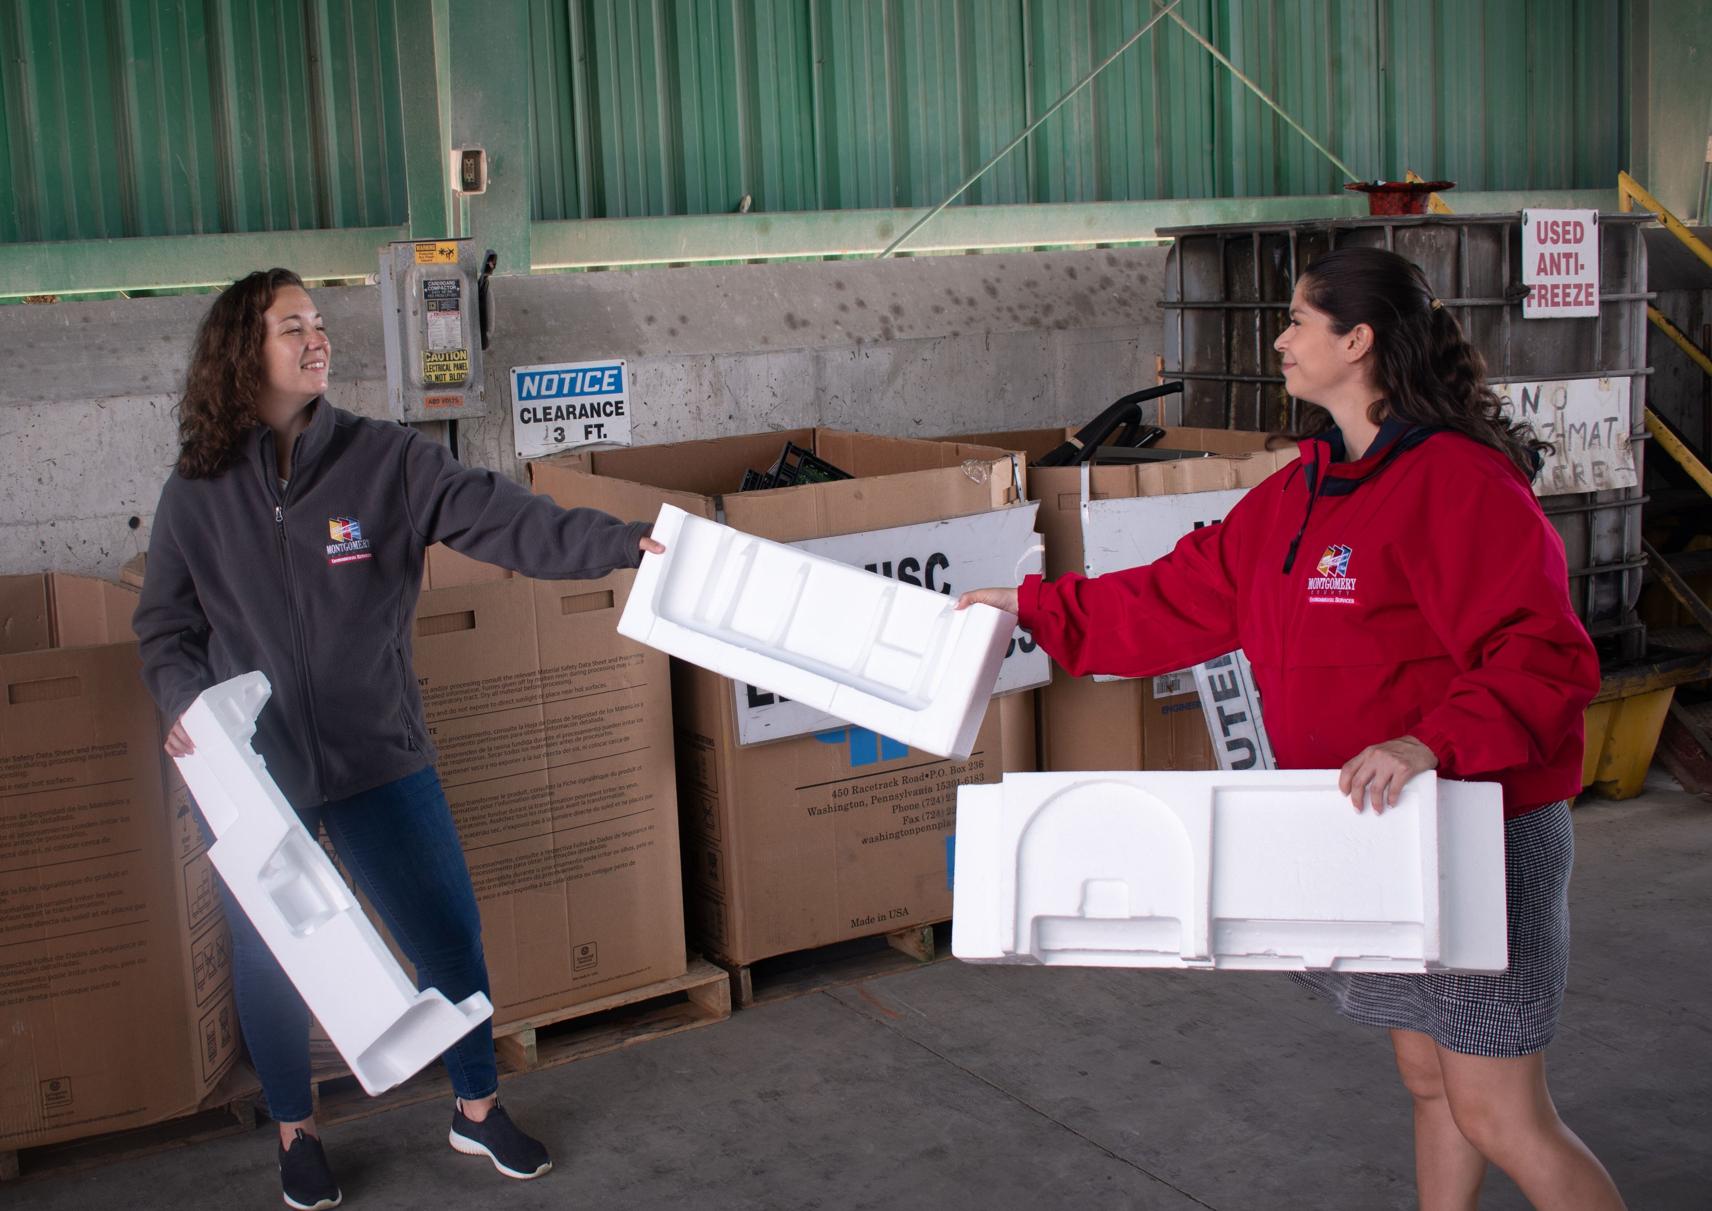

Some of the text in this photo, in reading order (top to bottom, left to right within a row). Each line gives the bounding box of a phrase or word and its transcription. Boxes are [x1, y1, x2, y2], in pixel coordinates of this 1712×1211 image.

[1536, 220, 1584, 245] USED
[1536, 252, 1585, 276] ANTI-
[1526, 283, 1595, 308] FREEZE
[426, 351, 467, 361] CAUTION
[434, 373, 447, 382] NOT
[521, 370, 618, 398] NOTICE
[1521, 385, 1568, 416] NO
[520, 400, 625, 424] CLEARANCE
[553, 423, 608, 442] 3 FT.
[326, 539, 370, 555] MONTGOMERY
[1307, 578, 1357, 591] MONTGOMERY
[831, 788, 850, 800] 450
[851, 778, 900, 795] Racetrack
[950, 765, 966, 777] Box
[968, 760, 984, 772] 236
[807, 800, 869, 817] Washington,
[871, 787, 934, 806] Pennsylvania
[892, 802, 920, 814] Phone
[902, 814, 920, 826] Fax
[850, 907, 910, 928] Made in USA
